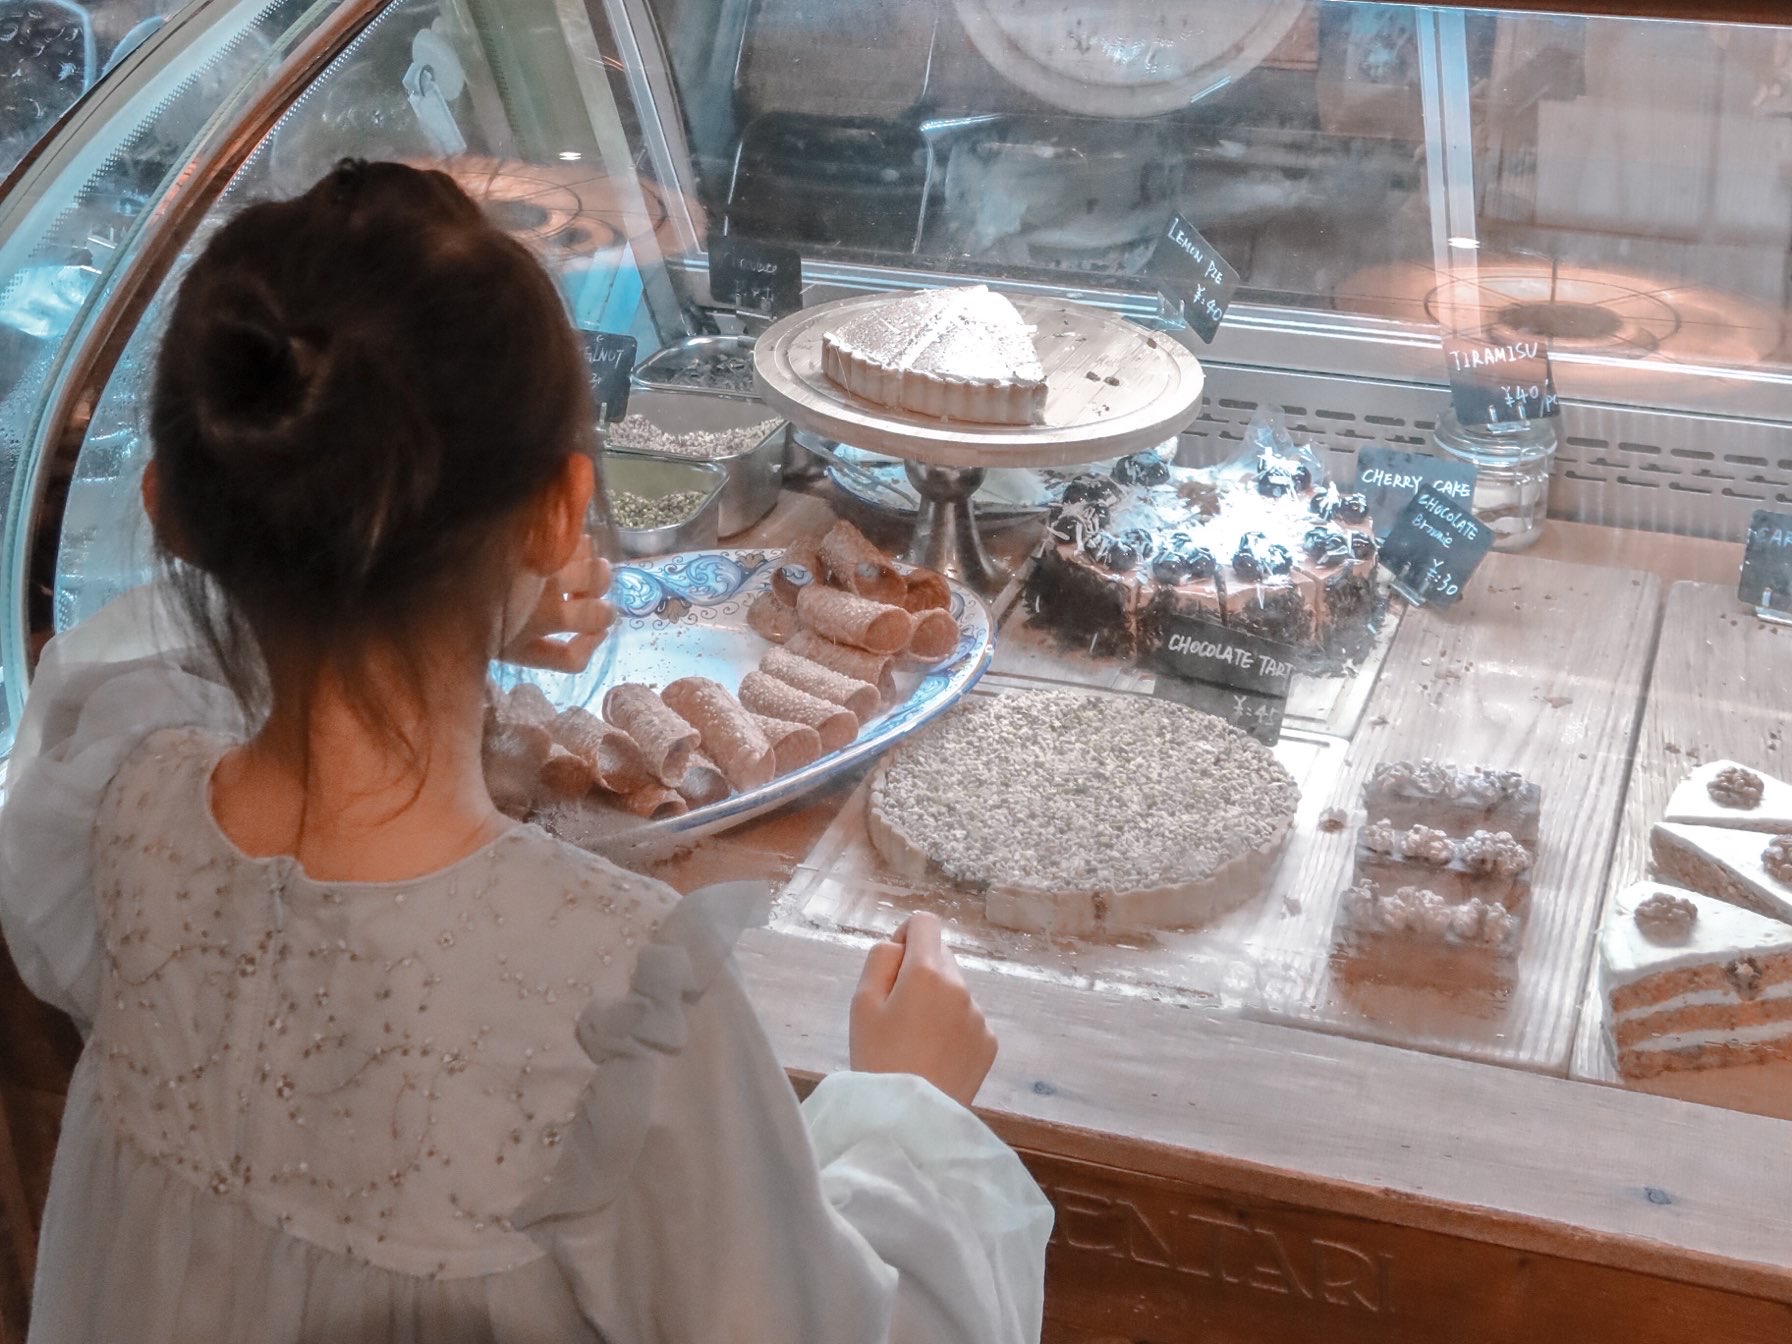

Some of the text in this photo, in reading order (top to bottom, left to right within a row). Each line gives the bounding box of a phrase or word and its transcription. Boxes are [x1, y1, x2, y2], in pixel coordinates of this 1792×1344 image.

[1167, 217, 1223, 285] LEMON PIE
[1449, 342, 1538, 371] TIRAMISU
[1361, 469, 1471, 498] CHERRY CAKE
[1168, 634, 1297, 677] CHOCOLATE TART
